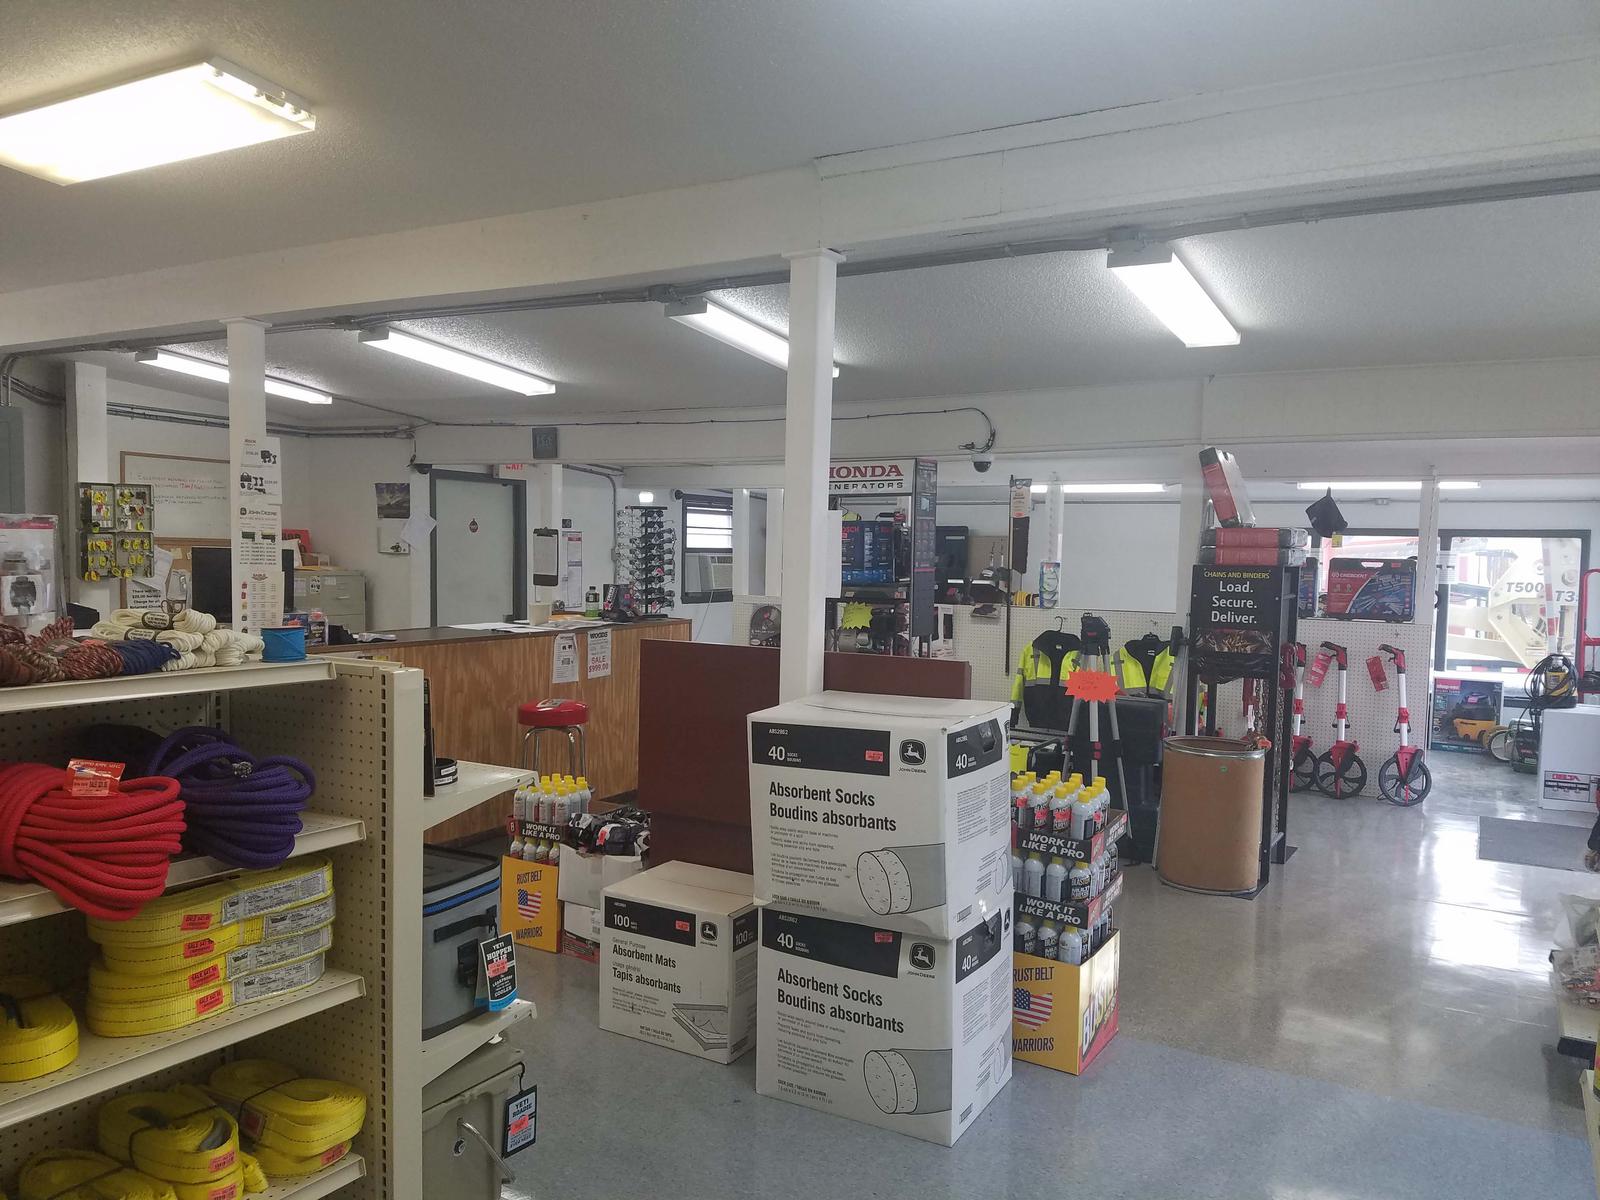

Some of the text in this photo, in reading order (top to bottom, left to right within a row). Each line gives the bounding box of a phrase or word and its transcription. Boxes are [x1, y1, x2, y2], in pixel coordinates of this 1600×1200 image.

[829, 482, 903, 490] NERATORS
[1219, 581, 1254, 593] Load.
[1506, 582, 1544, 593] T500
[1212, 595, 1258, 609] Secure.
[1555, 590, 1579, 602] T3
[1211, 611, 1257, 624] Deliver.
[768, 745, 786, 761] 40
[955, 753, 968, 770] 40
[769, 781, 875, 807] Absorbent Socks
[770, 802, 897, 832] Boudins absorbants
[522, 828, 538, 837] LIKE
[545, 833, 561, 841] PRO
[524, 823, 548, 833] WORK
[1029, 833, 1079, 849] WORK IT
[1022, 840, 1085, 859] LIKE A PRO
[1019, 904, 1081, 925] LIKE A PRO
[1026, 898, 1076, 915] WORK IT
[613, 914, 630, 928] 100
[492, 942, 505, 950] YETI
[777, 932, 794, 949] 40
[487, 946, 513, 961] HOPPER
[613, 944, 677, 969] Absorbent Mats
[962, 954, 972, 972] 40
[612, 967, 682, 994] Tapis absorbants
[1013, 966, 1055, 982] RUST BELT
[777, 967, 839, 997] Absorbent
[842, 984, 883, 1007] Socks
[777, 988, 905, 1034] Boudins absorbants
